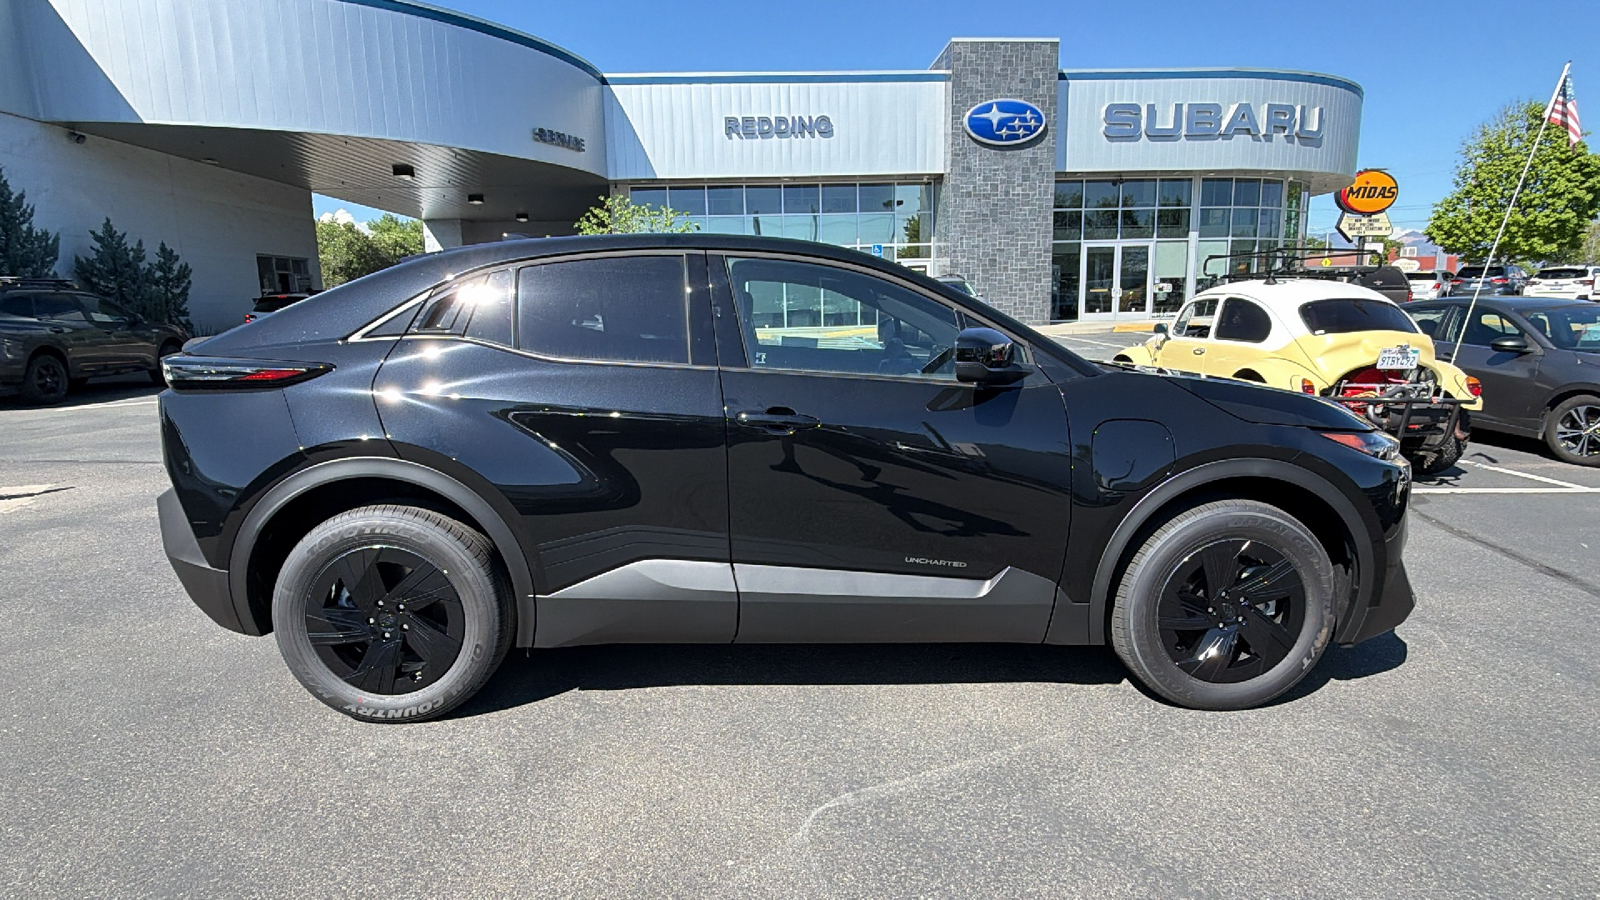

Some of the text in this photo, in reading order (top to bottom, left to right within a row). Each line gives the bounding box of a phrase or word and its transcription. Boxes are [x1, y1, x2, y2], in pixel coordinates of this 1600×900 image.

[724, 115, 832, 137] REDDING
[1103, 102, 1324, 144] SUBARU
[1347, 186, 1397, 199] MIDAS
[904, 556, 968, 568] UNCHARTED
[344, 696, 445, 720] COUNTRY
